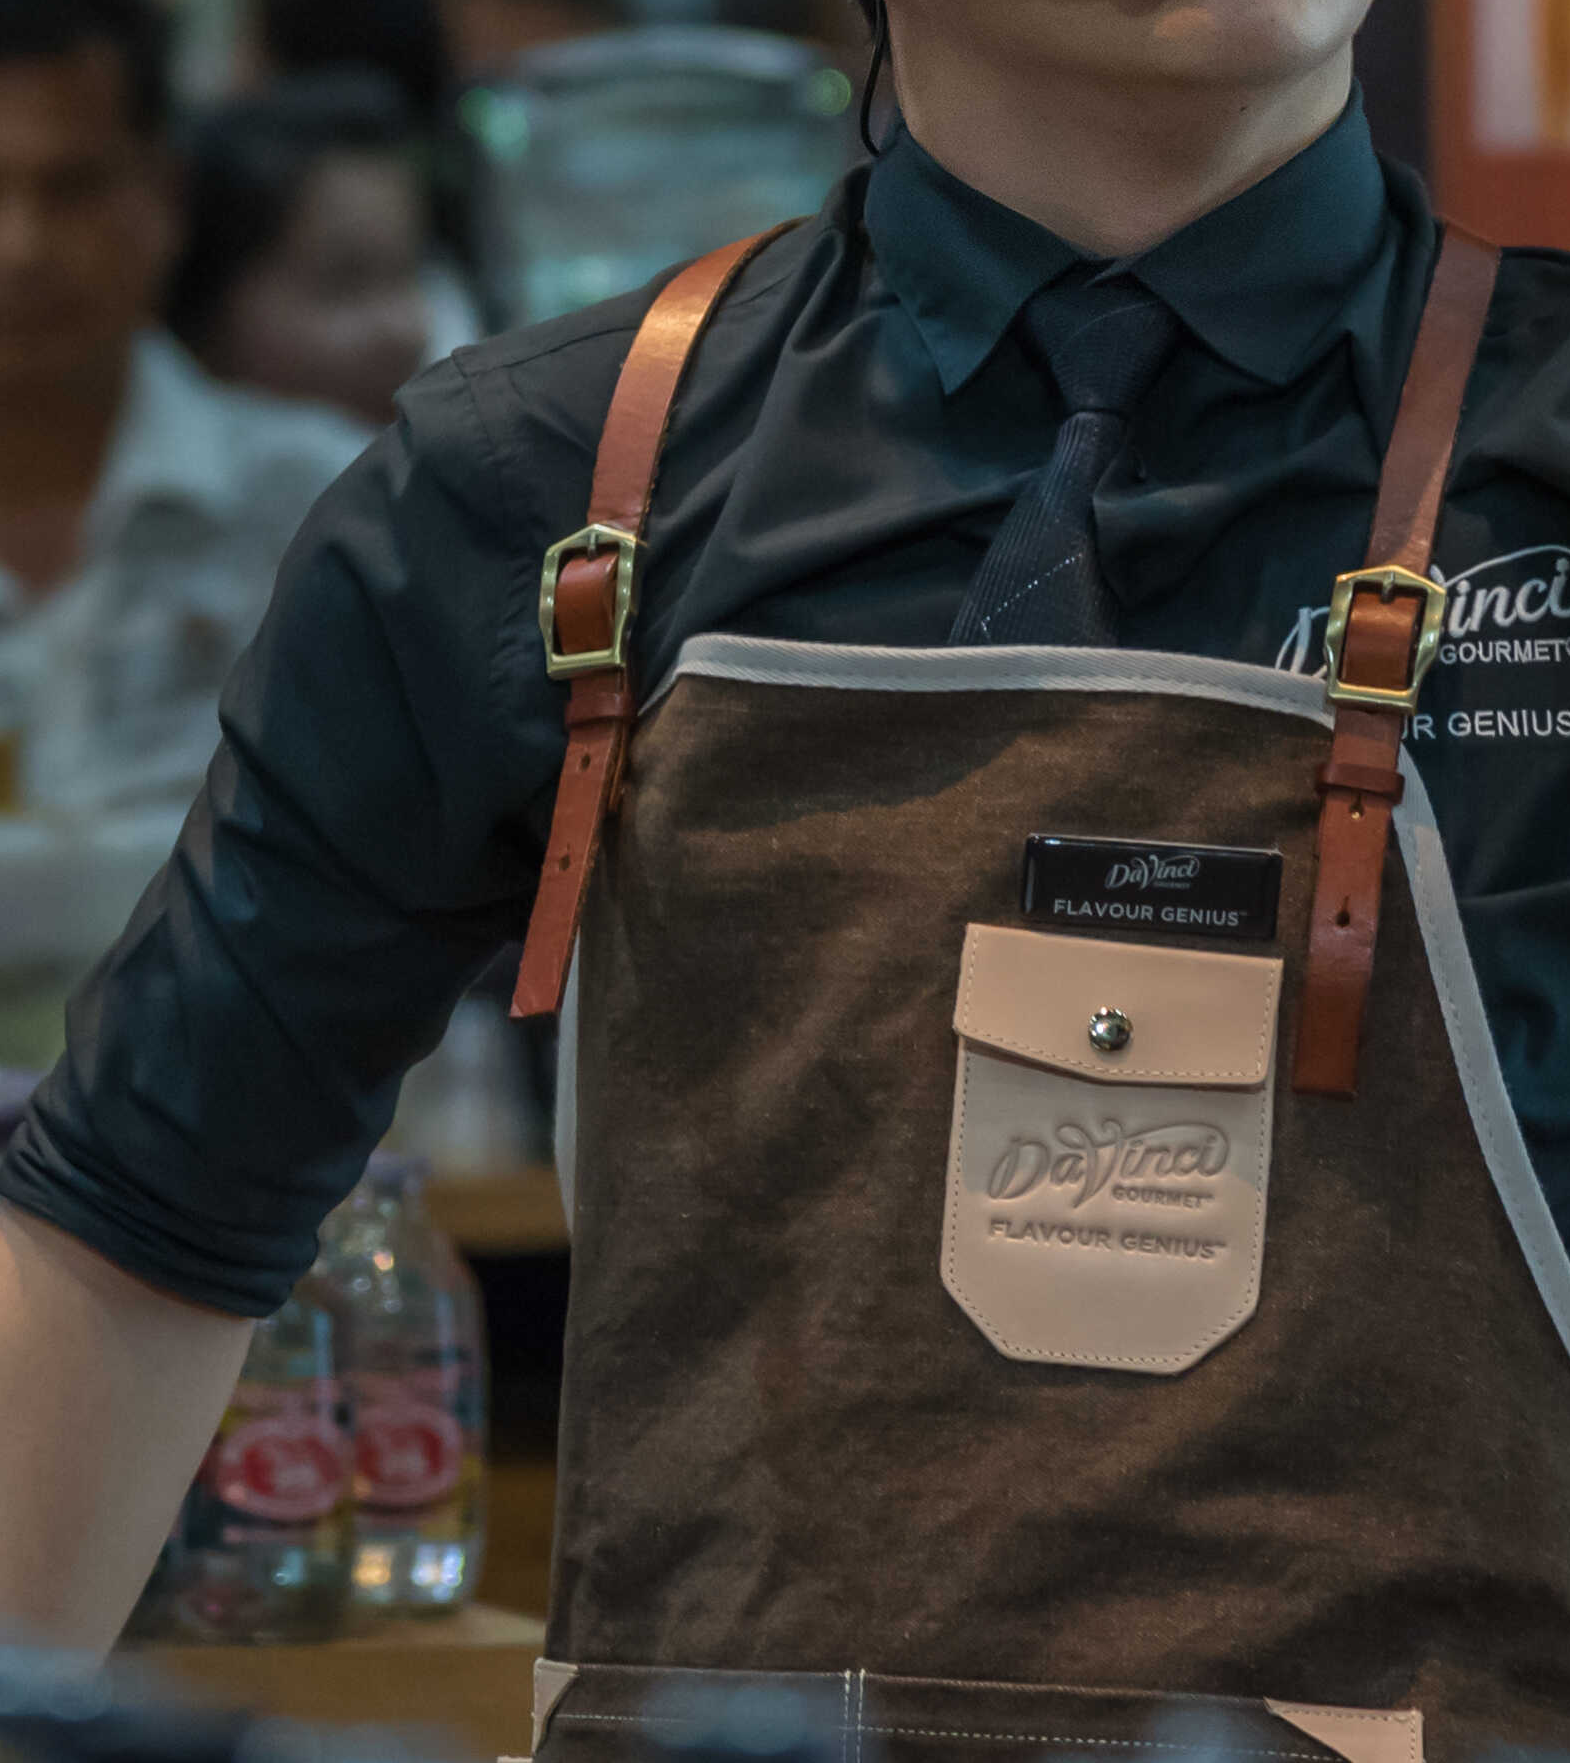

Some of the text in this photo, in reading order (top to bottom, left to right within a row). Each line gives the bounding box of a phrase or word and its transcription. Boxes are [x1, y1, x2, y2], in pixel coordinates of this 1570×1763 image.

[1104, 854, 1200, 891] DaVinci
[1054, 898, 1154, 921] FLAVOUR
[987, 1118, 1229, 1209] DaVinci
[990, 1218, 1112, 1249] FLAVOUR
